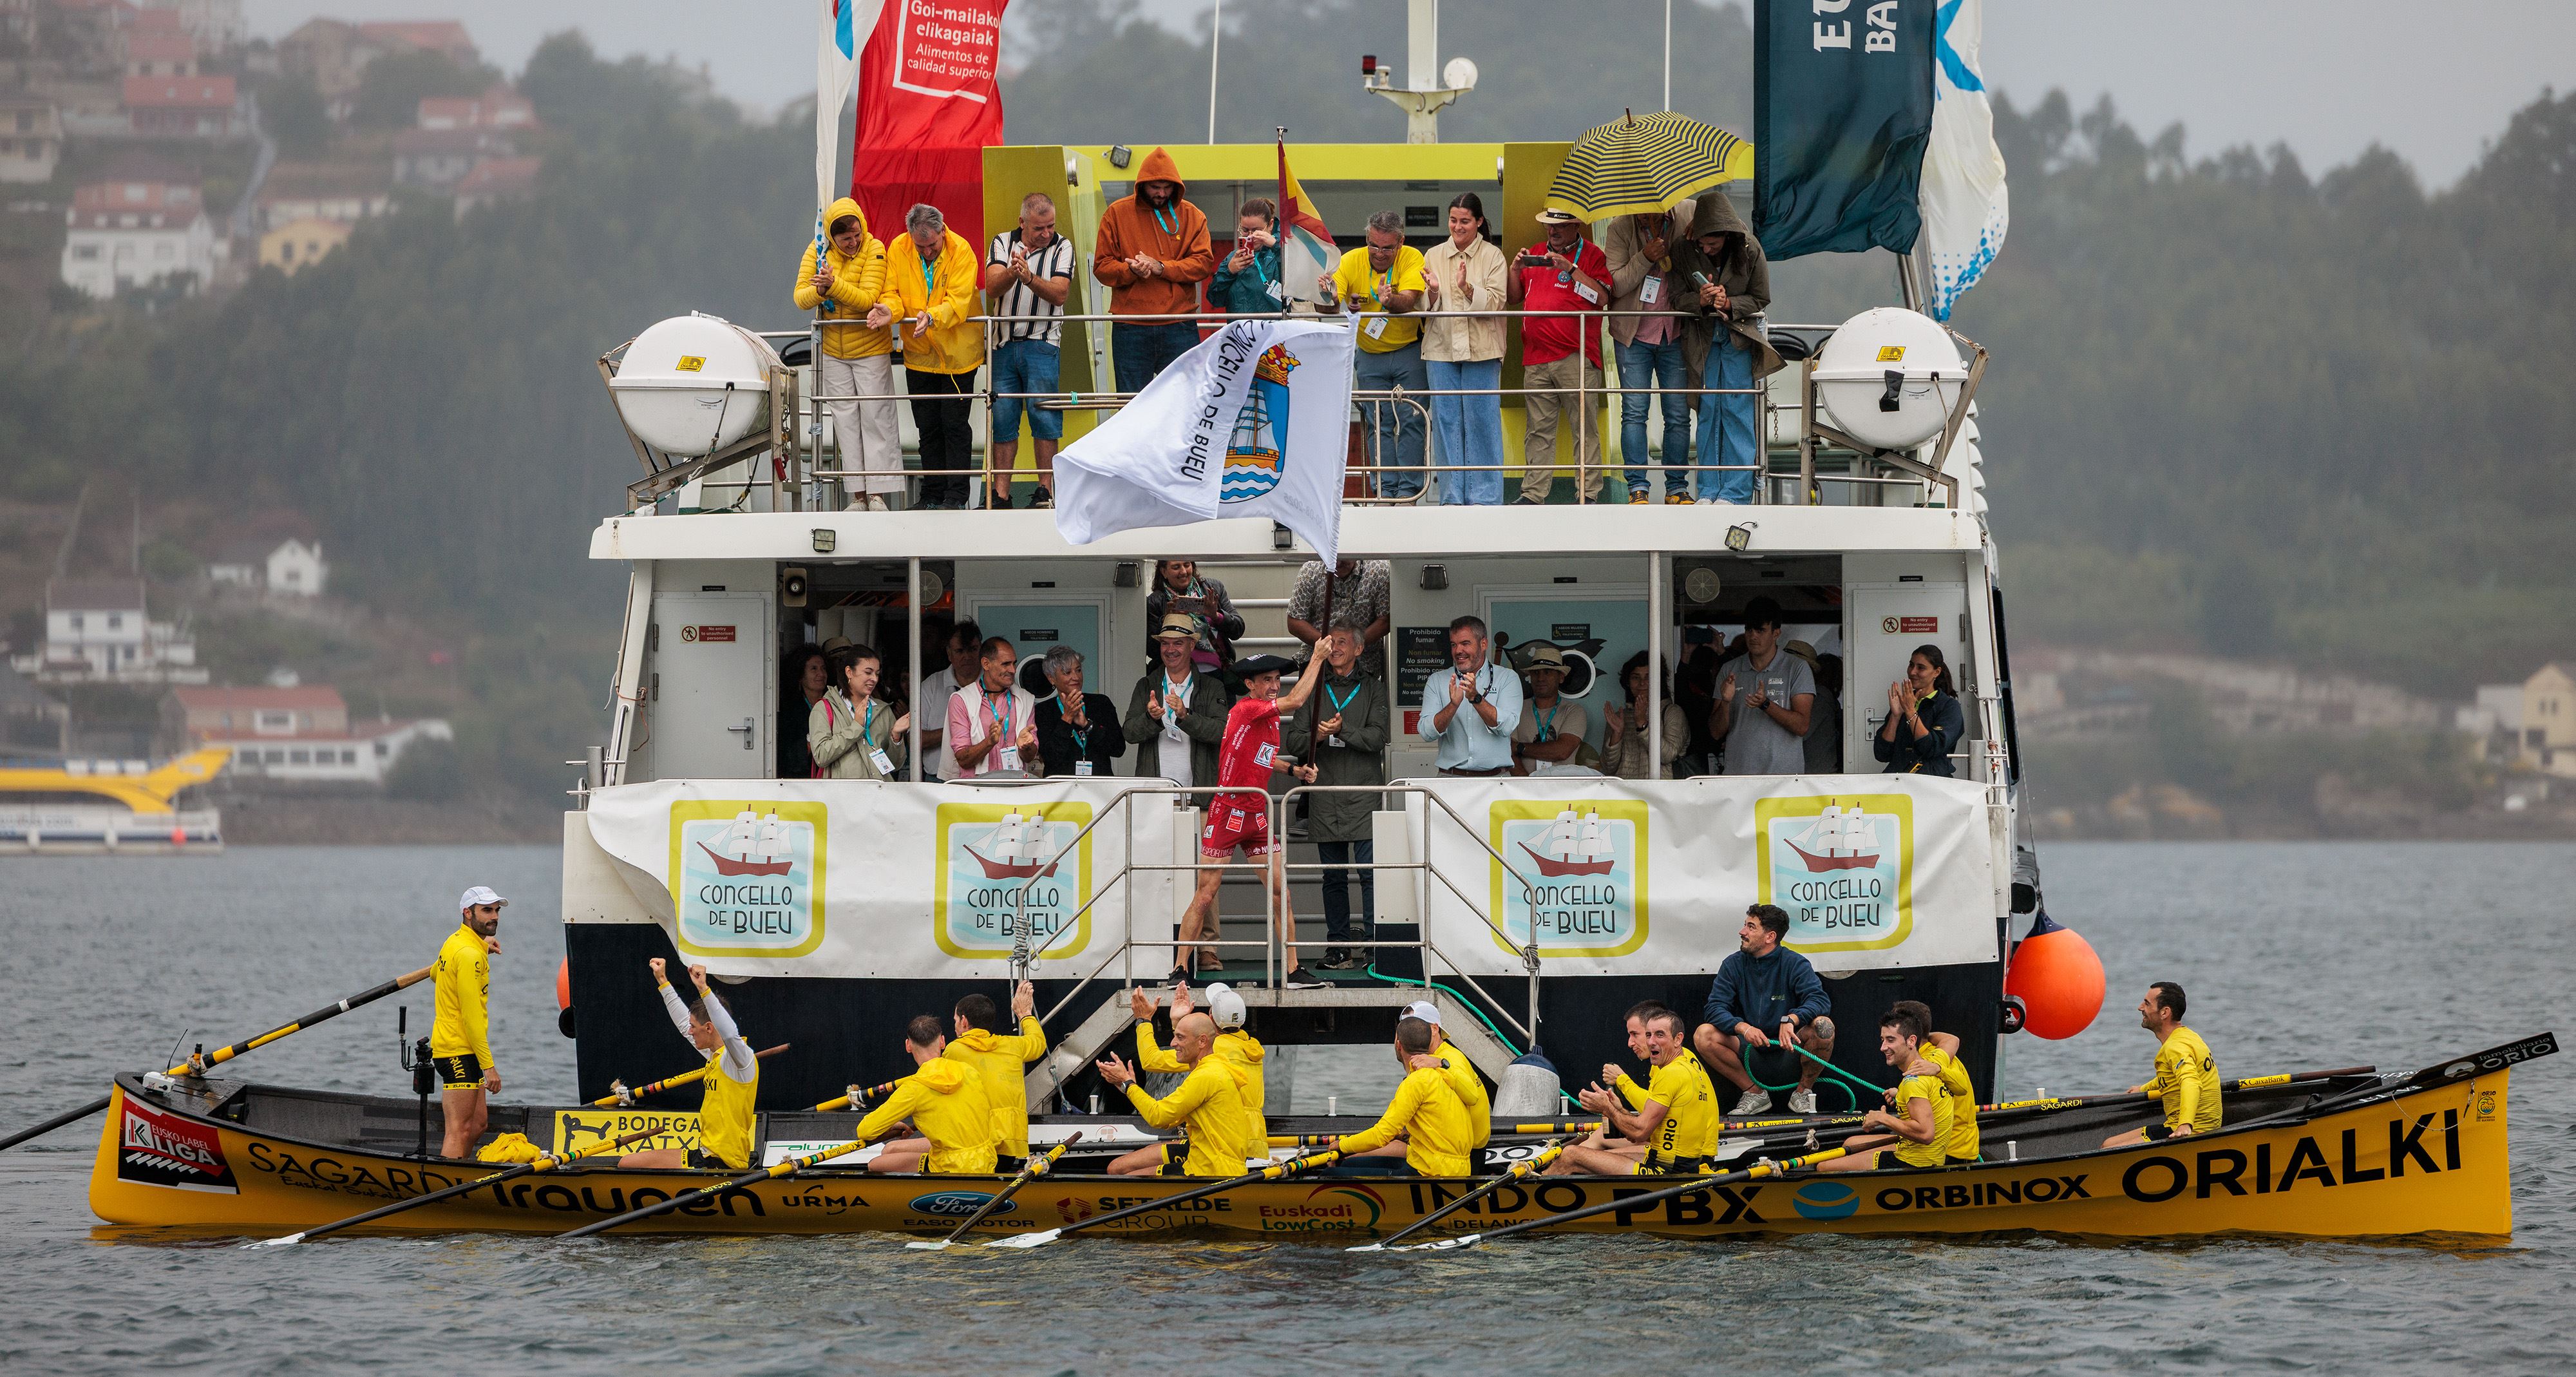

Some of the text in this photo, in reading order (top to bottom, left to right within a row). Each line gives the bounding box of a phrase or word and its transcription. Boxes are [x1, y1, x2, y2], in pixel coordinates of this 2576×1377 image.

[911, 0, 999, 29] Goi-mailako
[916, 22, 994, 46] elikagaiak
[916, 43, 989, 65] Alimentos de
[907, 59, 992, 81] calidad superior
[1199, 404, 1218, 430] DE
[1180, 434, 1209, 482] BUEU
[710, 911, 791, 934] DE BUEU
[976, 913, 994, 928] DE
[1558, 910, 1615, 934] BUEU
[1801, 904, 1880, 928] DE BUEU
[2479, 1037, 2550, 1061] Inmobiliaria
[2482, 1043, 2552, 1068] ORIO
[2249, 1076, 2285, 1086] CaixaBank
[2041, 1099, 2082, 1111] SAGARDI
[152, 1124, 211, 1151] EUSKO LABEL
[1663, 1119, 1678, 1151] ORIO
[154, 1135, 218, 1166] LIGA
[2121, 1108, 2461, 1203] ORIALKI
[248, 1142, 469, 1199] SAGARDI
[279, 1174, 336, 1193] Euskal
[1875, 1173, 2092, 1211] ORBINOX
[782, 1195, 870, 1208] URMA
[931, 1196, 995, 1213] For
[1259, 1204, 1352, 1217] Euskadi
[1409, 1183, 1768, 1227] INDO PBX
[1261, 1217, 1356, 1232] LowCost
